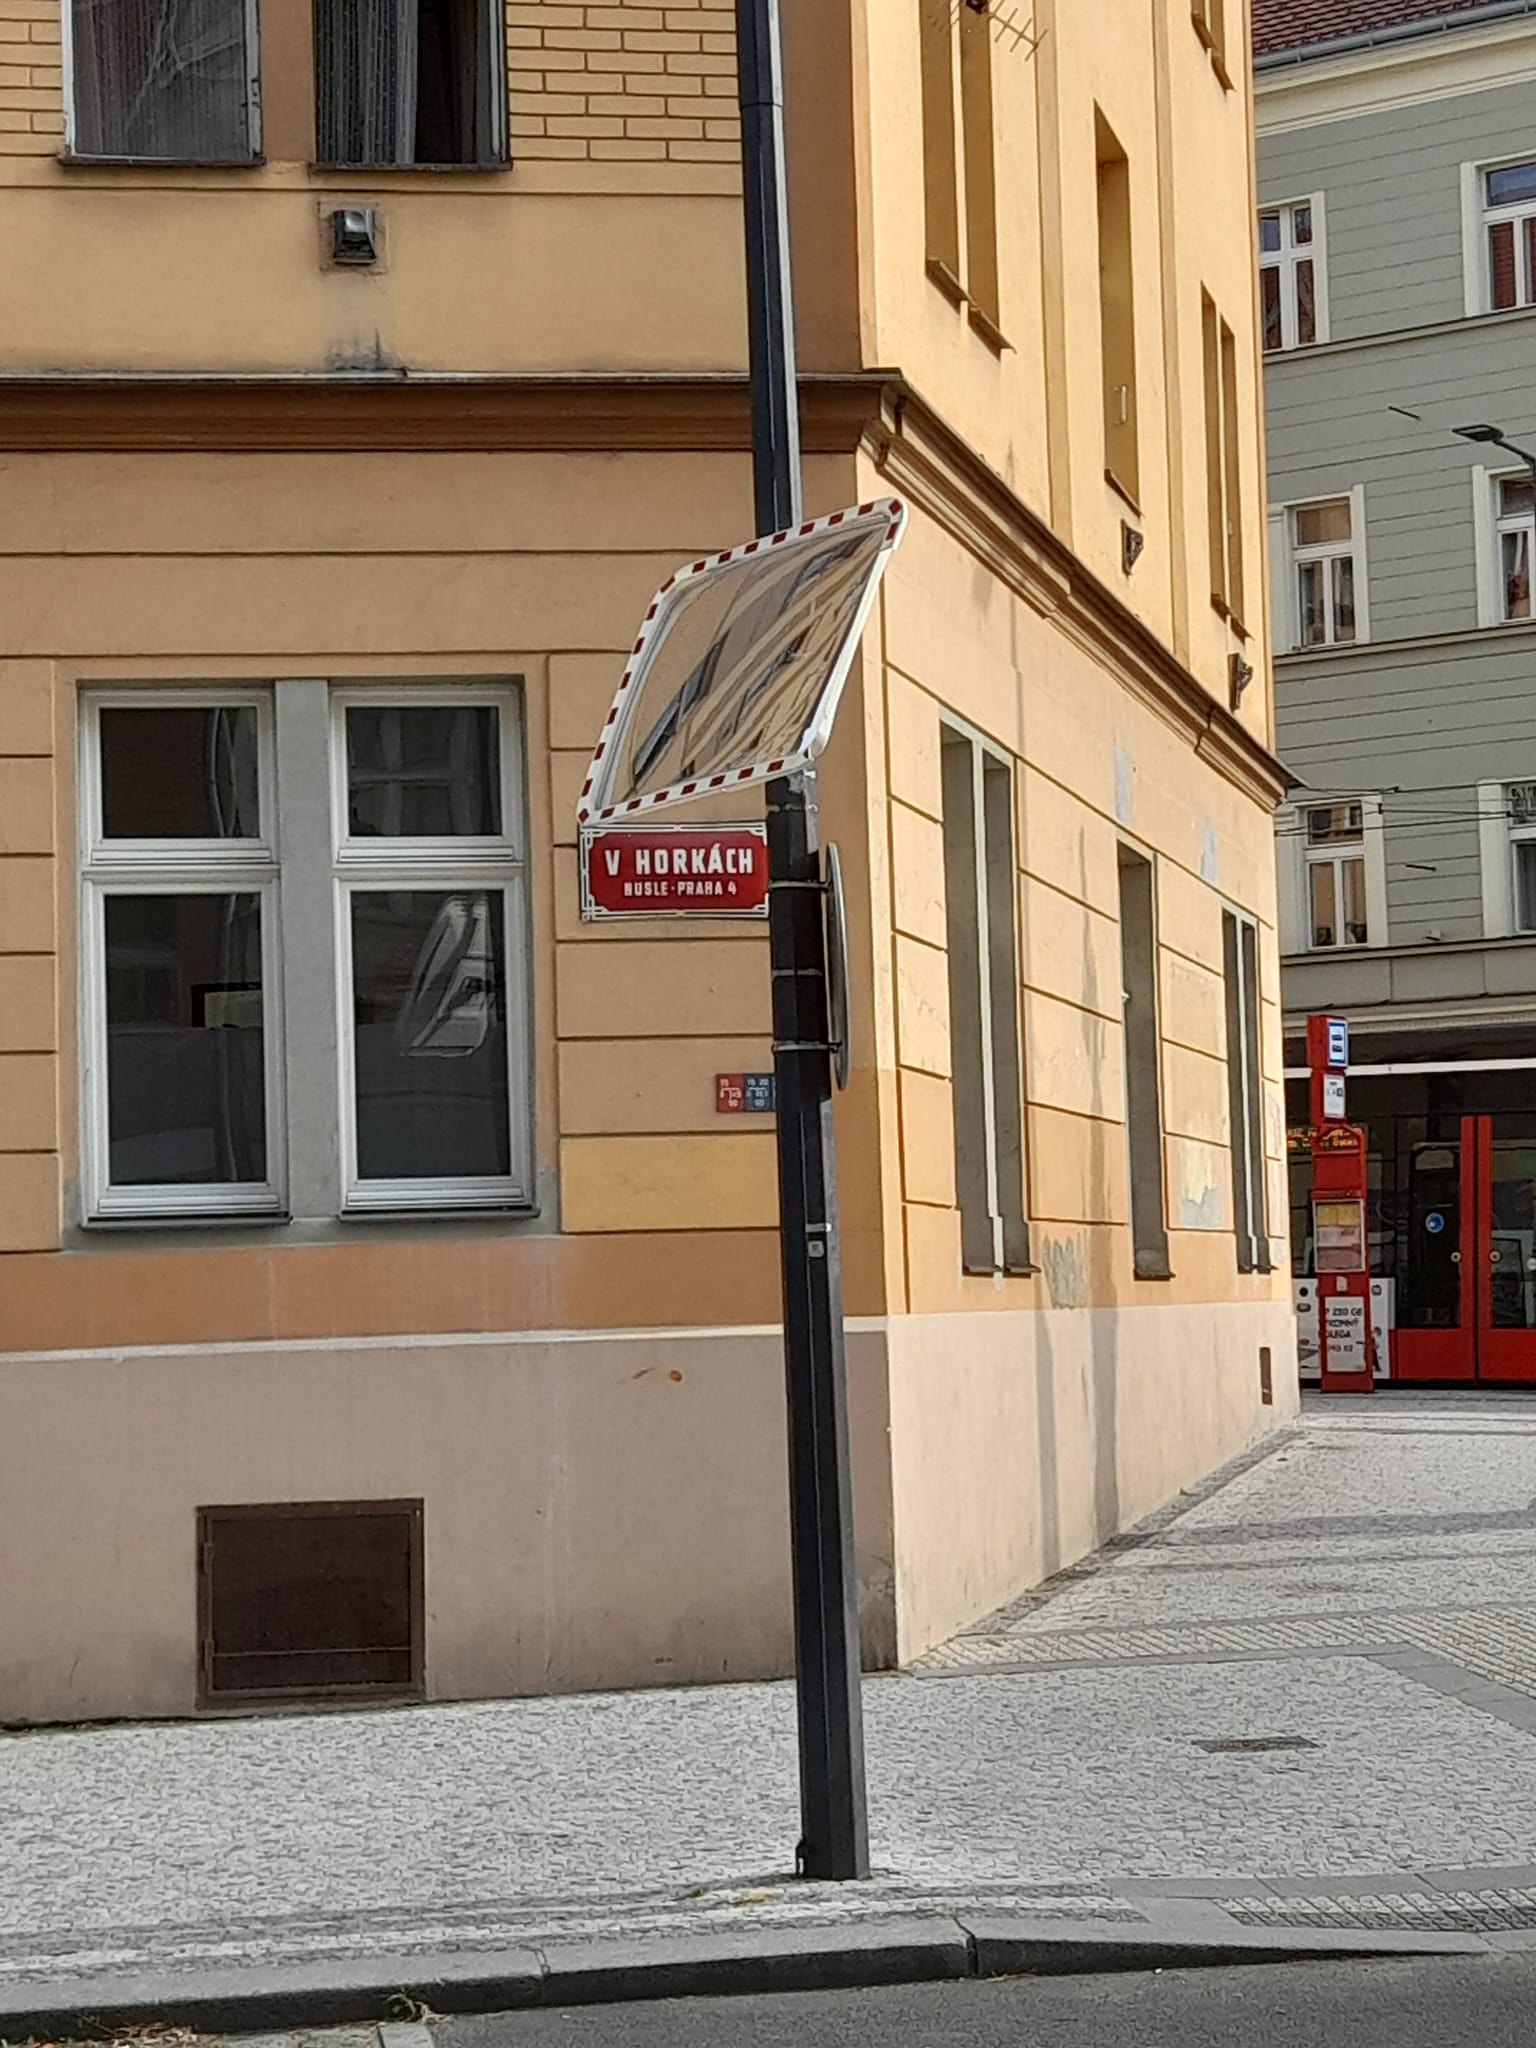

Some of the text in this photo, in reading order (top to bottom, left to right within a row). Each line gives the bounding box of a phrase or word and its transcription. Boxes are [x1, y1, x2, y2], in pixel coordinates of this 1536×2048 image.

[604, 843, 753, 876] V HORKÁCH
[727, 880, 737, 896] 4
